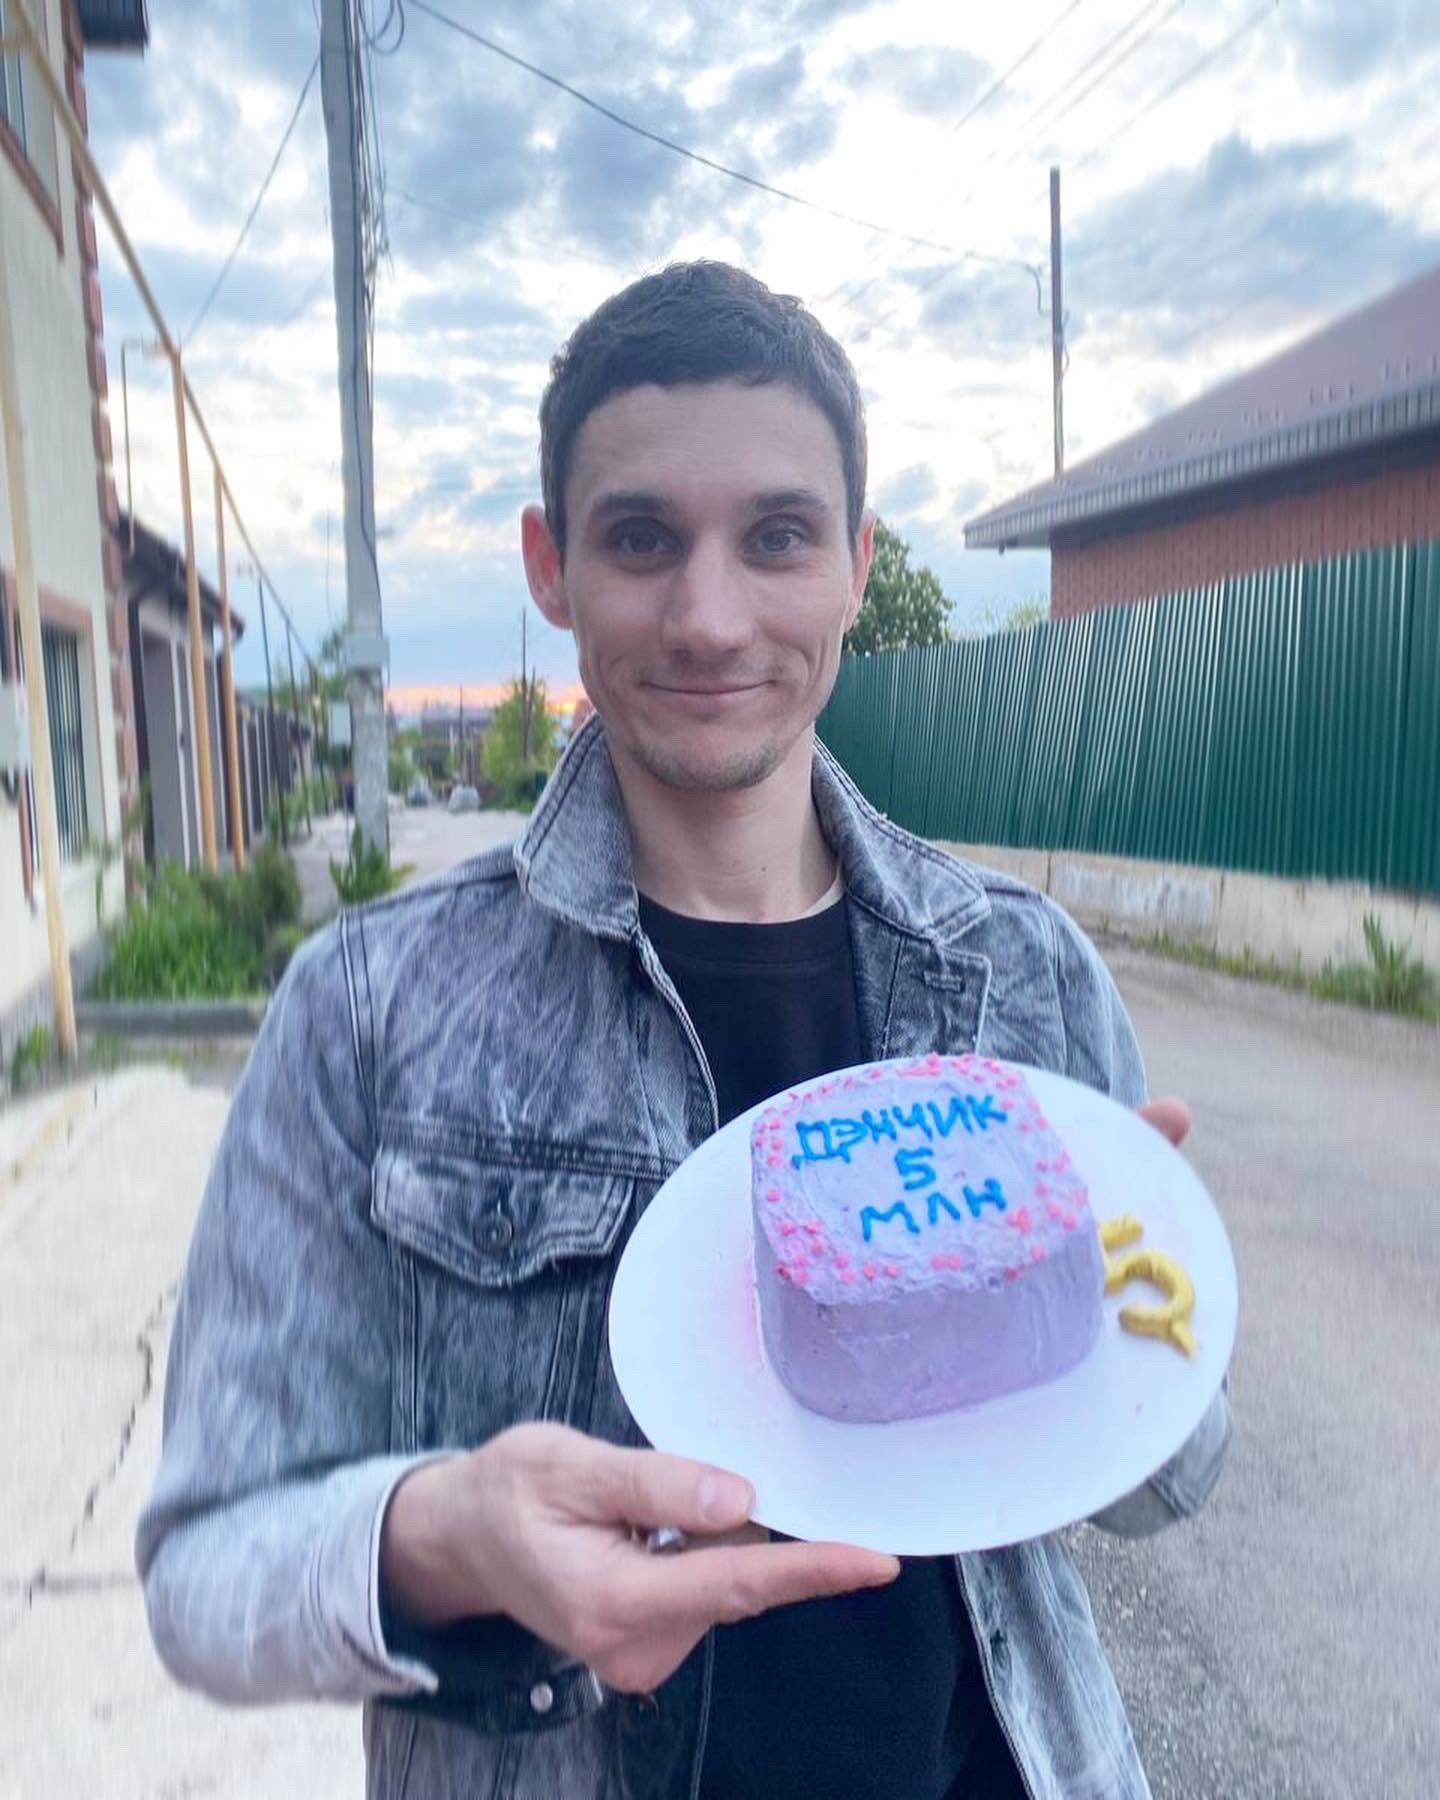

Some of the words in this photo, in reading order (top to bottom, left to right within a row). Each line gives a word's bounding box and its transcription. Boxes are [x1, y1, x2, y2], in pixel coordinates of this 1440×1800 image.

[791, 1094, 1008, 1171] ДЭНЧИК
[894, 1146, 937, 1191] 5
[859, 1177, 1008, 1242] МЛН
